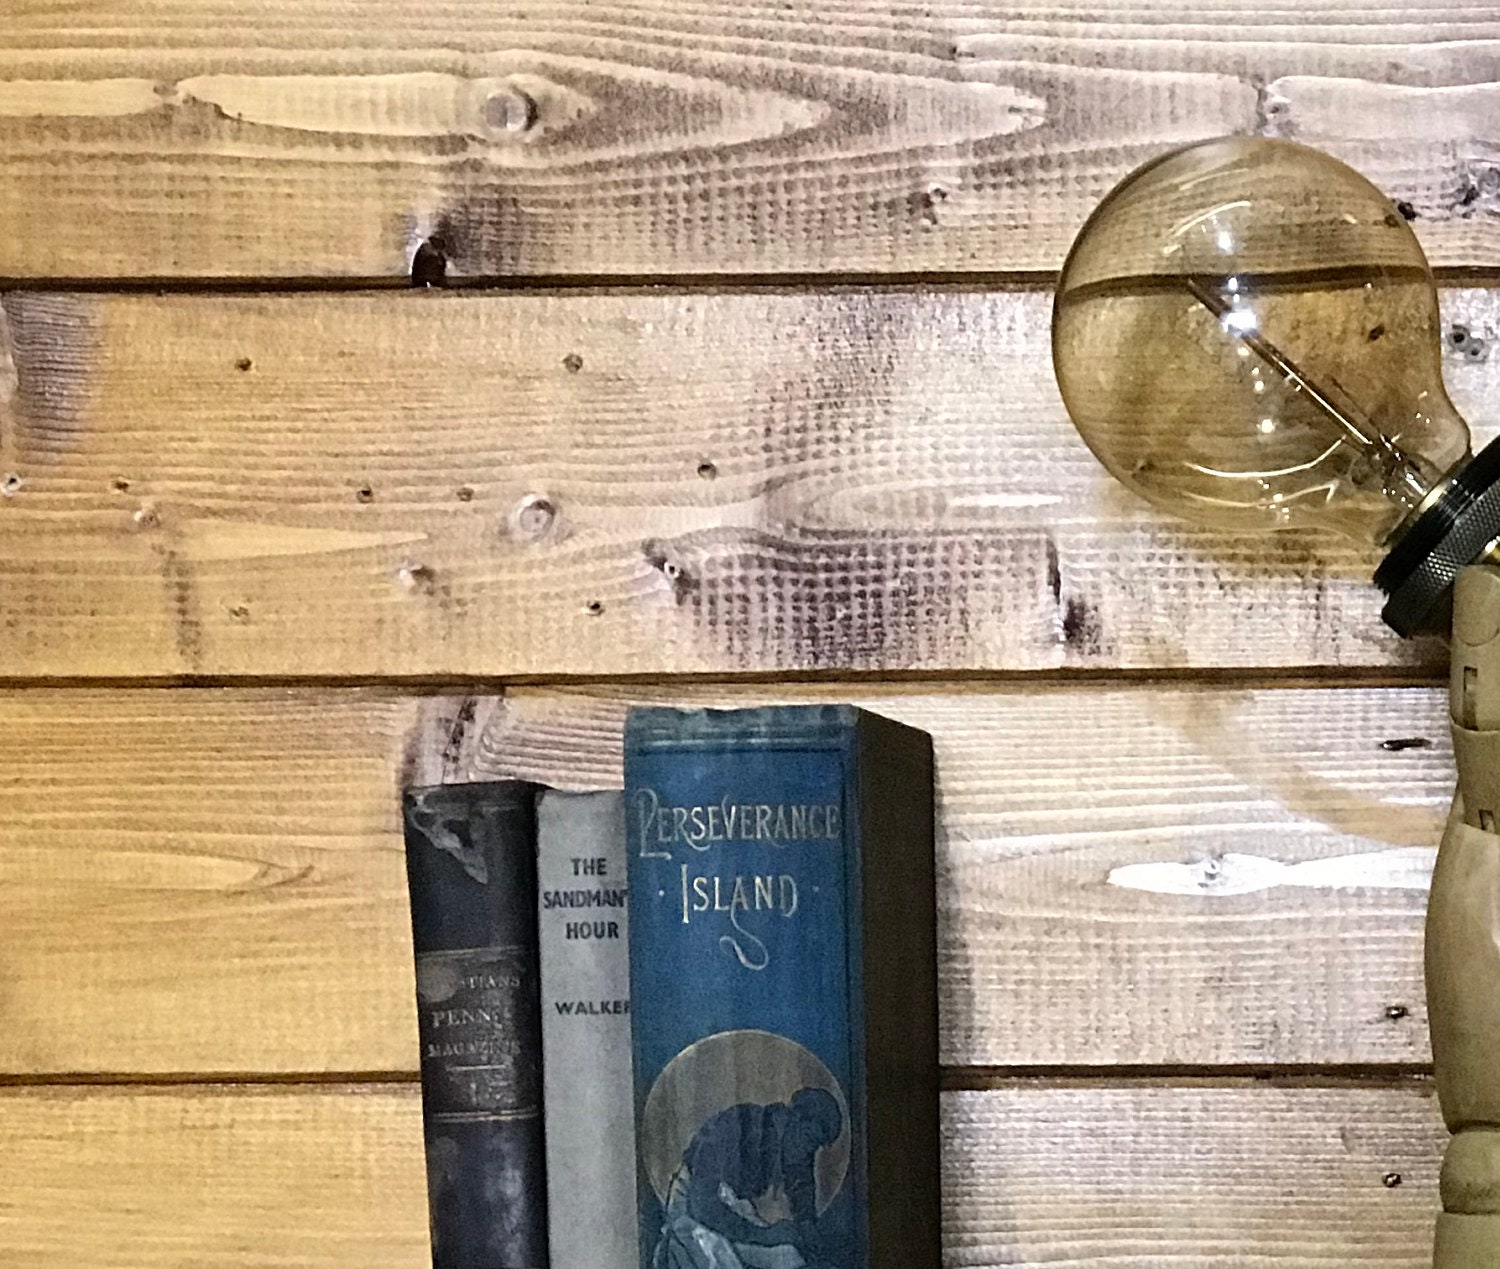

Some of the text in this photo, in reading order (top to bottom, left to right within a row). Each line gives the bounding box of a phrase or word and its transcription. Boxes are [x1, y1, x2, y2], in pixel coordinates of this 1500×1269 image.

[633, 788, 841, 860] PERSEVERANCE
[570, 857, 607, 877] THE
[566, 921, 620, 940] HOUR
[681, 863, 799, 970] ISLAND
